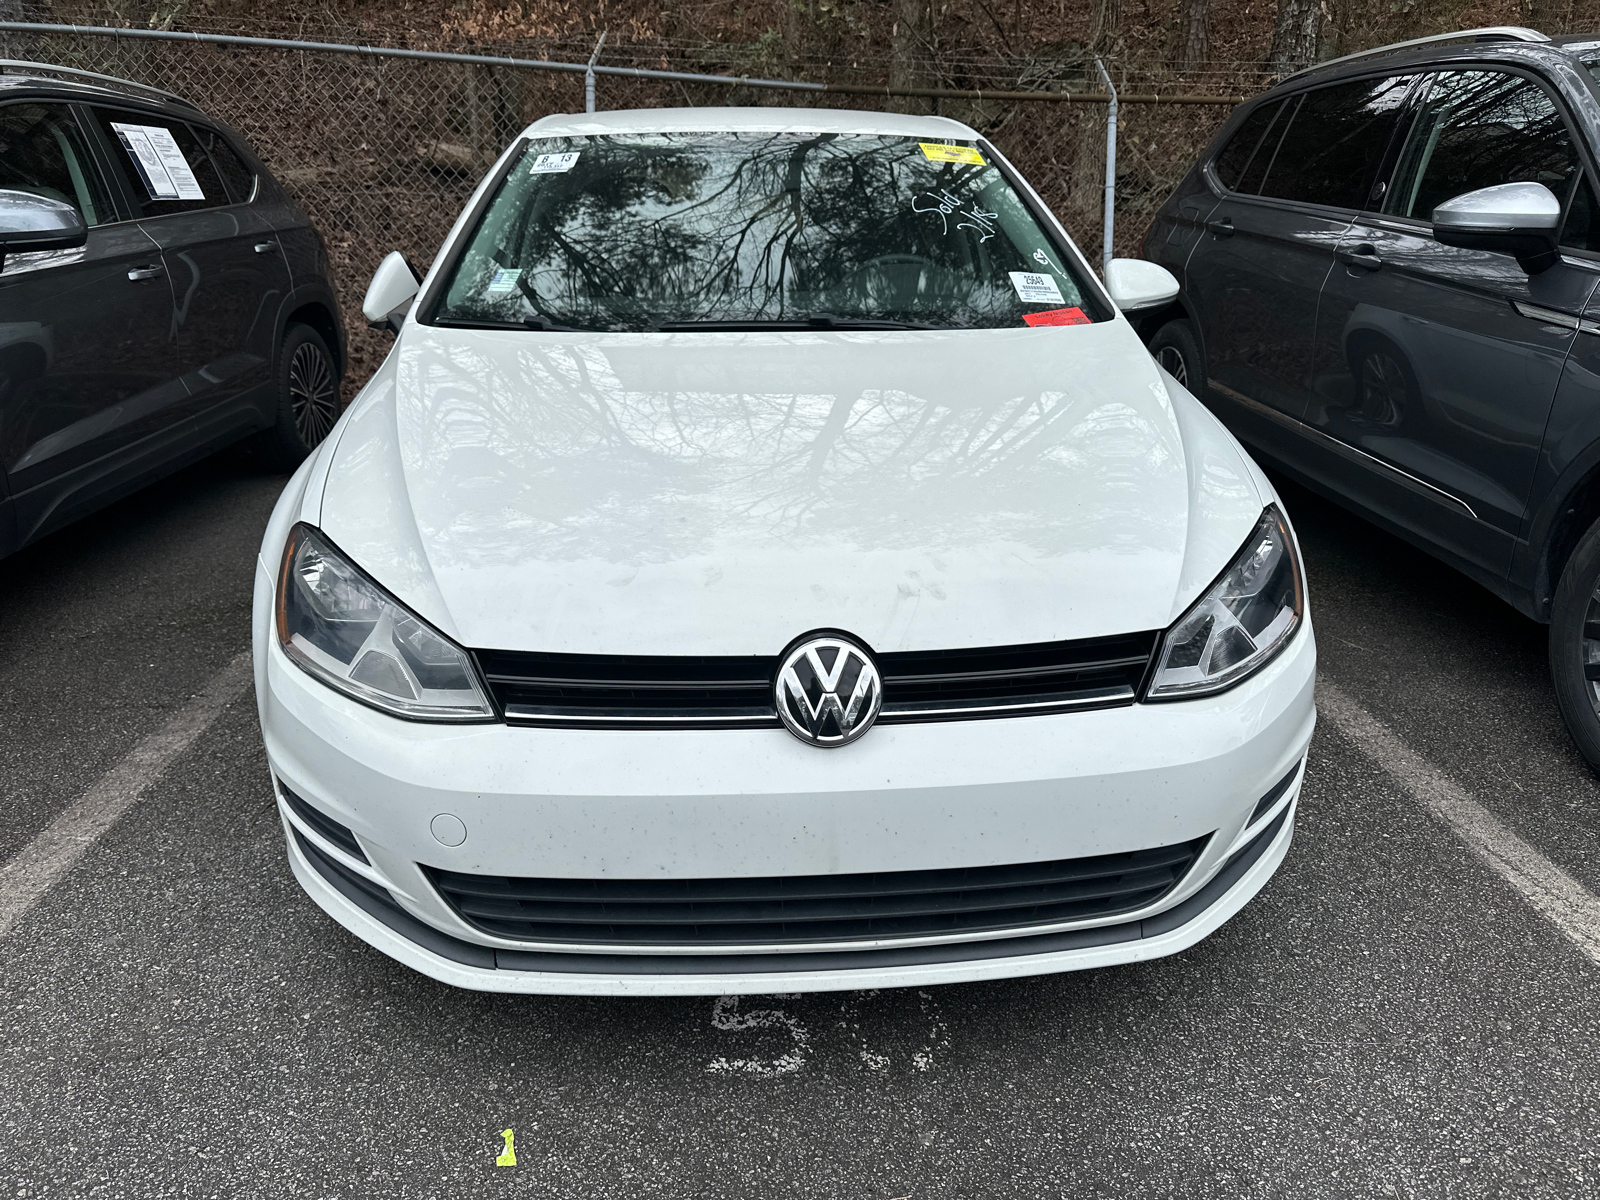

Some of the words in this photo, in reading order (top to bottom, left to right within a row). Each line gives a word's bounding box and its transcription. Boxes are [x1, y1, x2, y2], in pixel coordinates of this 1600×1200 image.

[560, 154, 572, 162] 13
[911, 188, 965, 235] Sold
[775, 637, 882, 748] VW
